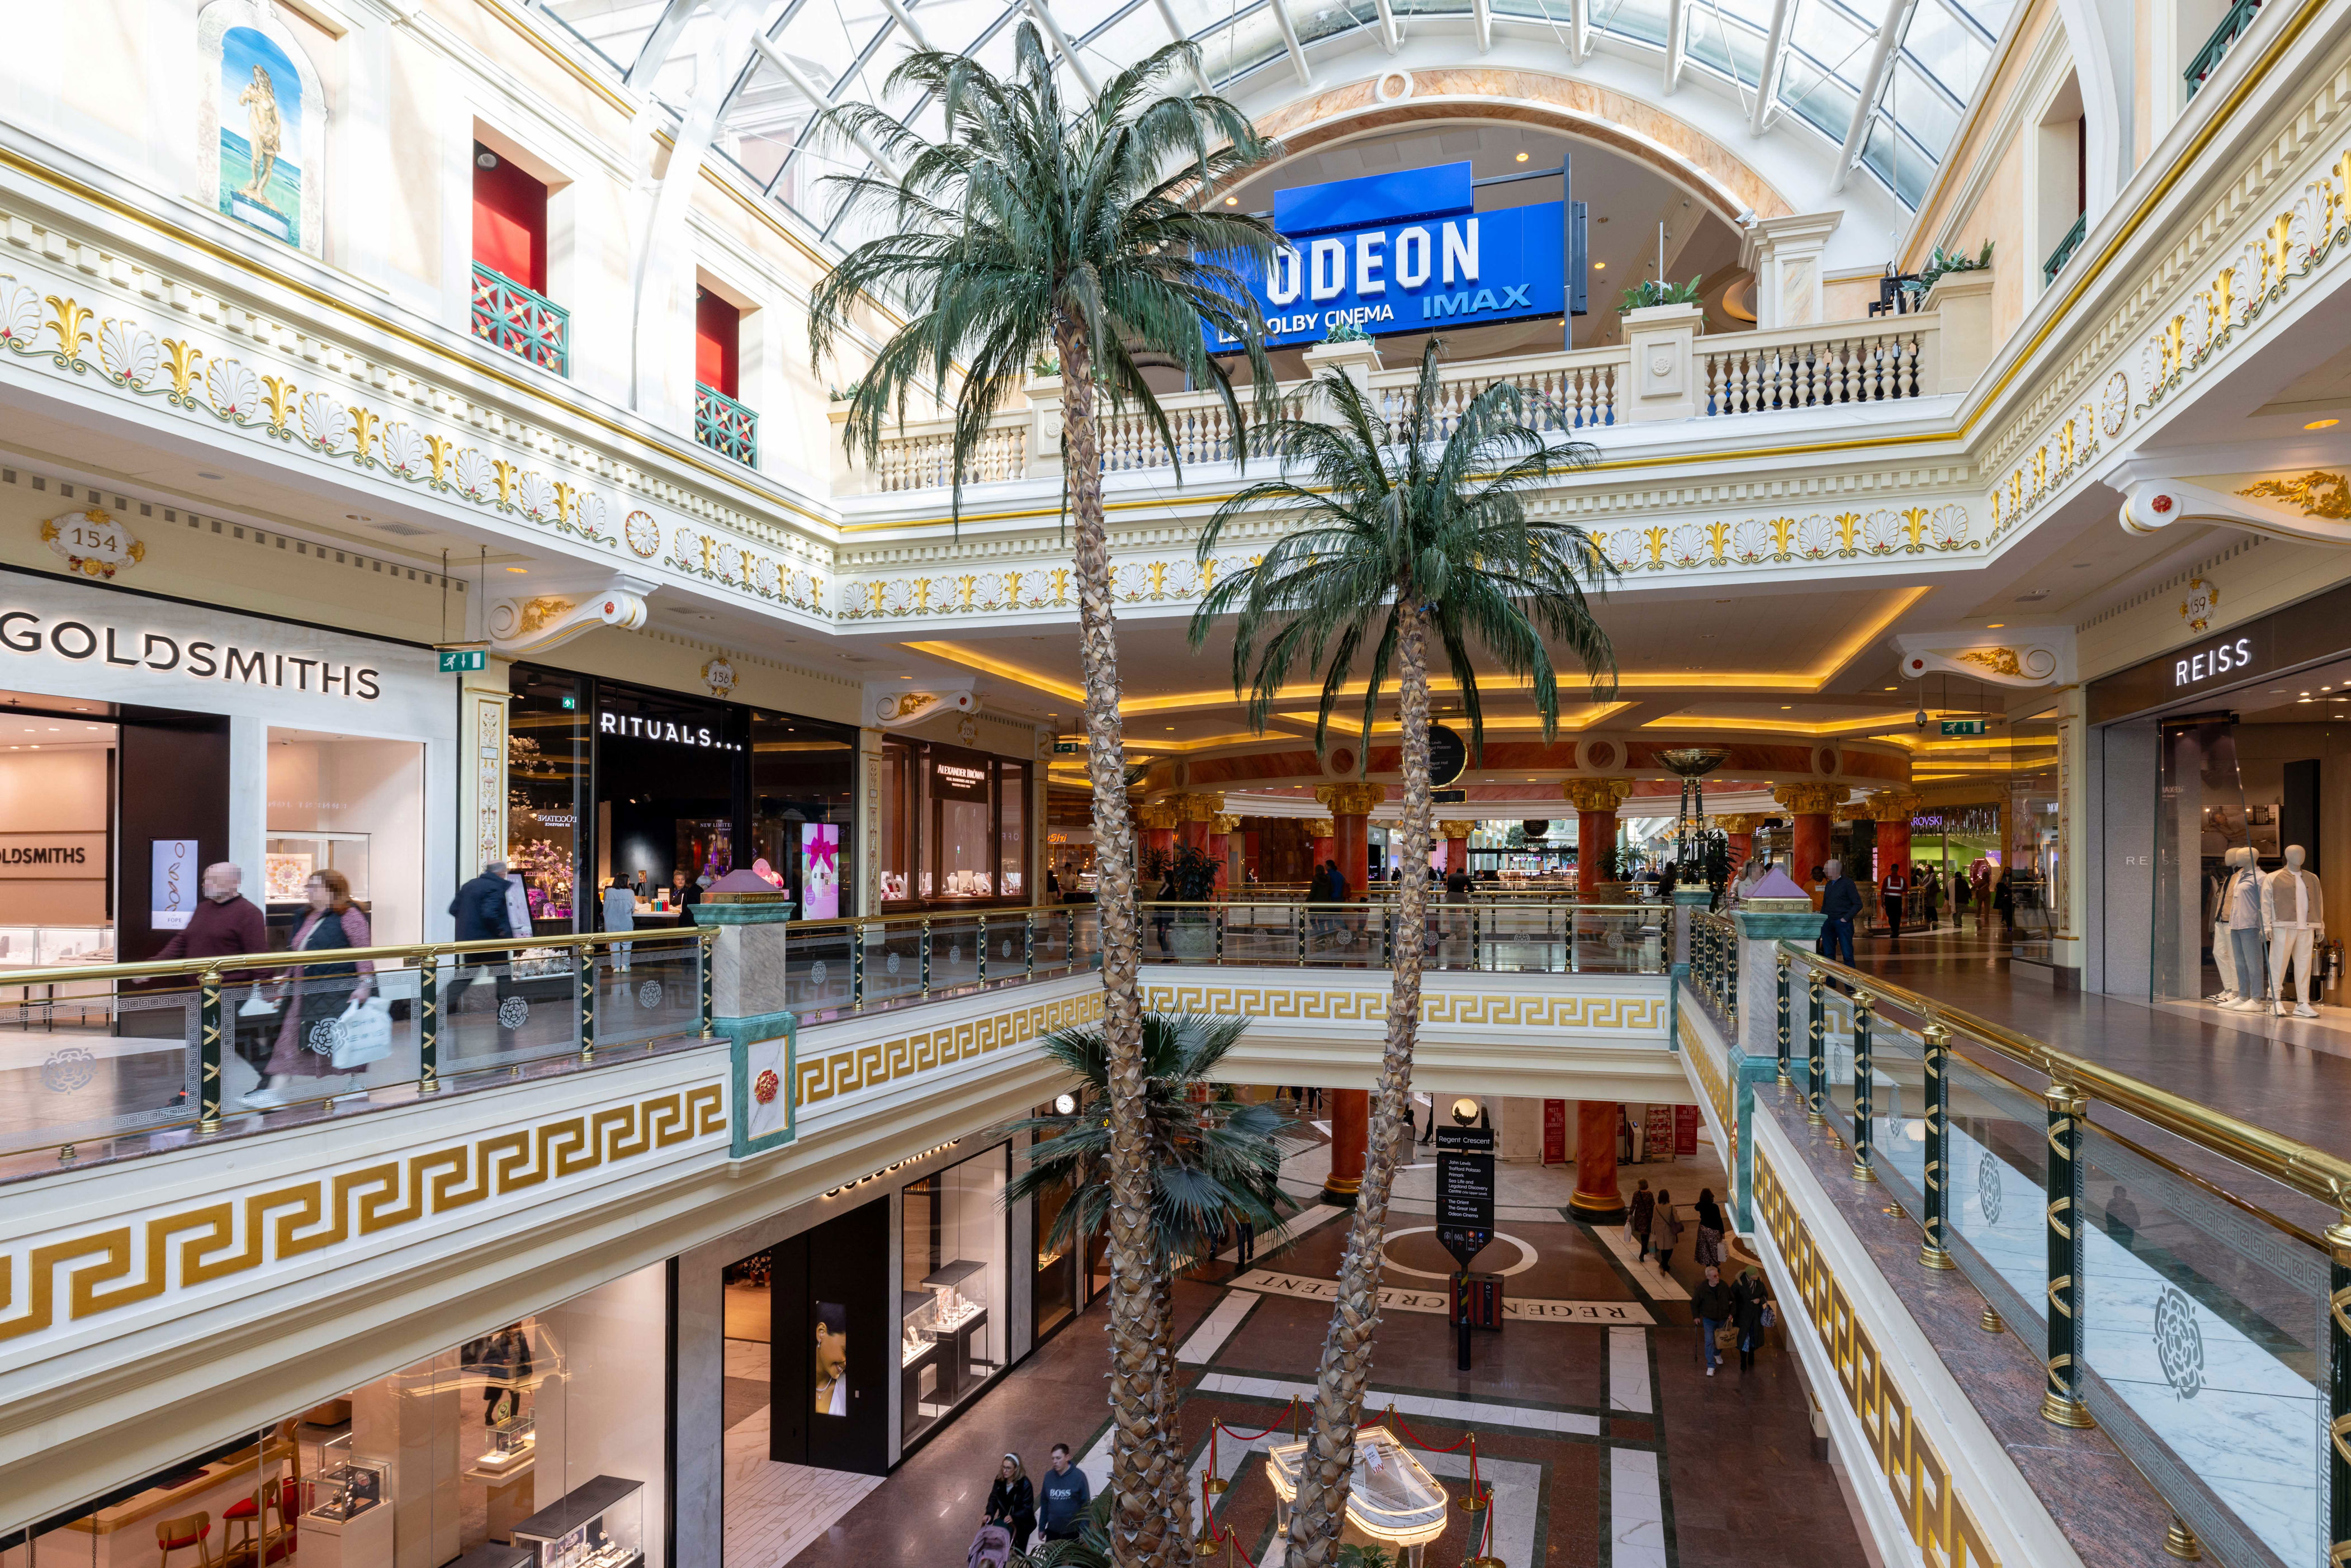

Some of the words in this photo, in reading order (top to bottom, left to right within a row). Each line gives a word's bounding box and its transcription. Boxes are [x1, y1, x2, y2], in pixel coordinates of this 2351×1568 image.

[1267, 217, 1479, 307] ODEON
[1423, 283, 1532, 318] IMAX
[1324, 304, 1394, 328] CINEMA
[72, 528, 117, 552] 154
[0, 612, 380, 700] GOLDSMITHS
[2177, 638, 2251, 686] REISS
[713, 671, 729, 684] 156
[937, 764, 966, 777] ALEXANDER
[2126, 856, 2181, 865] RESS
[1256, 1276, 1445, 1308] CRECENT
[1501, 1303, 1630, 1318] REGEN
[1050, 1489, 1071, 1497] BOSS
